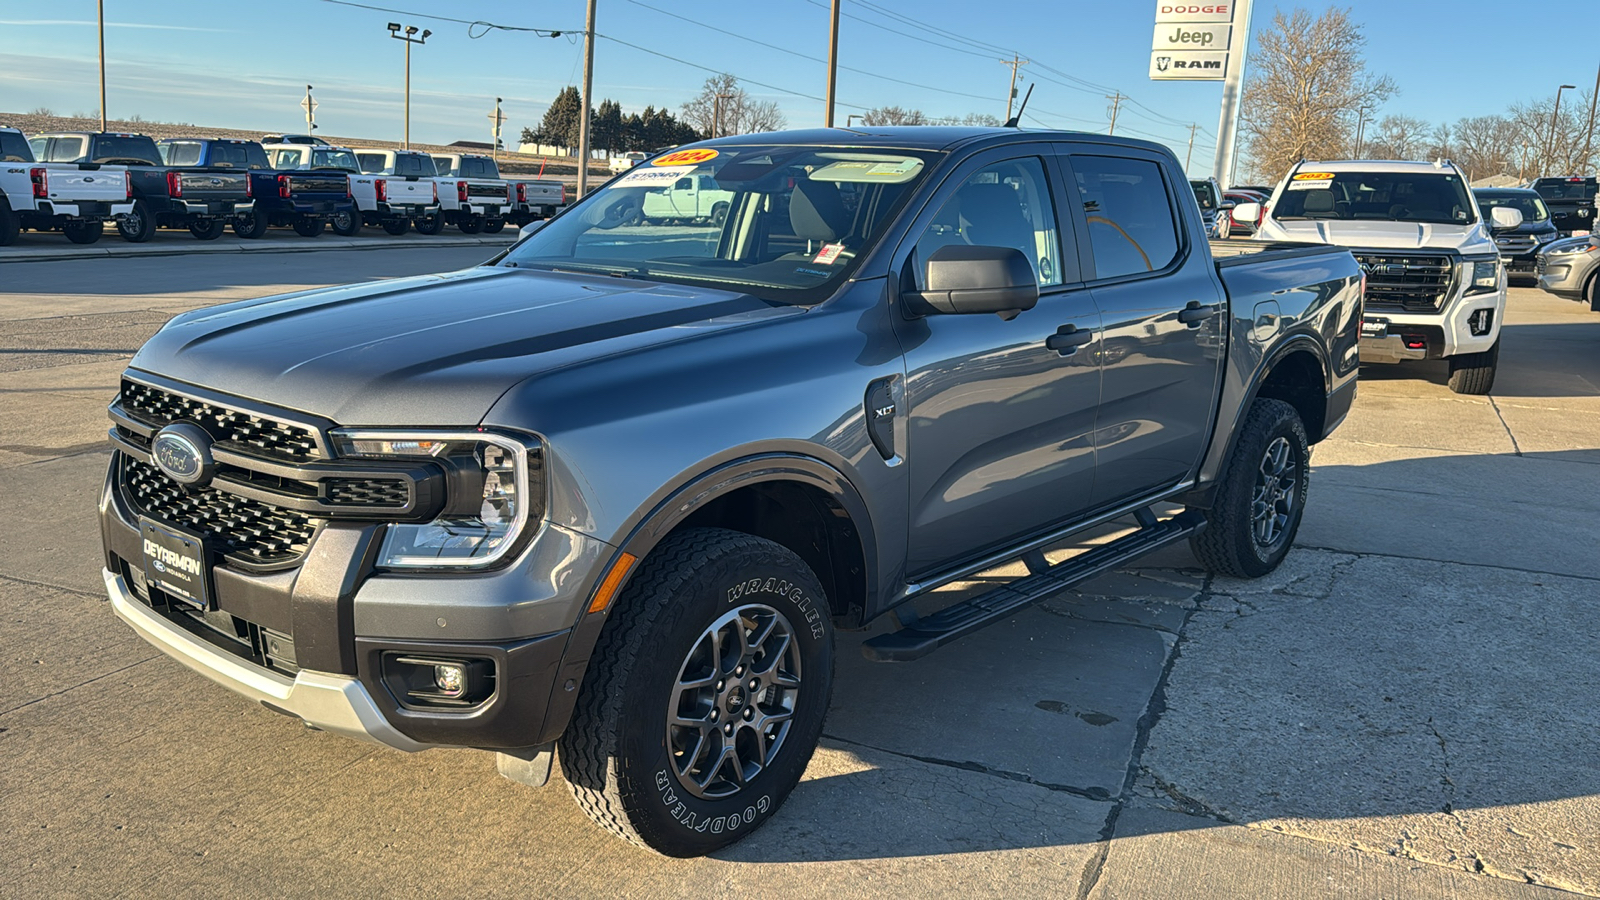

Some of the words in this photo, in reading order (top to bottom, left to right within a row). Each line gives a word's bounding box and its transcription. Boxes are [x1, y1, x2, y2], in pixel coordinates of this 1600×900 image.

[1161, 5, 1228, 14] DODGE
[1168, 27, 1214, 47] Jeep
[1174, 60, 1221, 69] RAM
[656, 151, 715, 163] 2024
[1359, 263, 1407, 276] MC
[875, 404, 895, 419] XLT
[161, 446, 187, 472] Ford
[143, 538, 200, 576] DEYARMAN
[727, 577, 825, 640] WRANGLER
[655, 769, 771, 834] GOODYEAR
